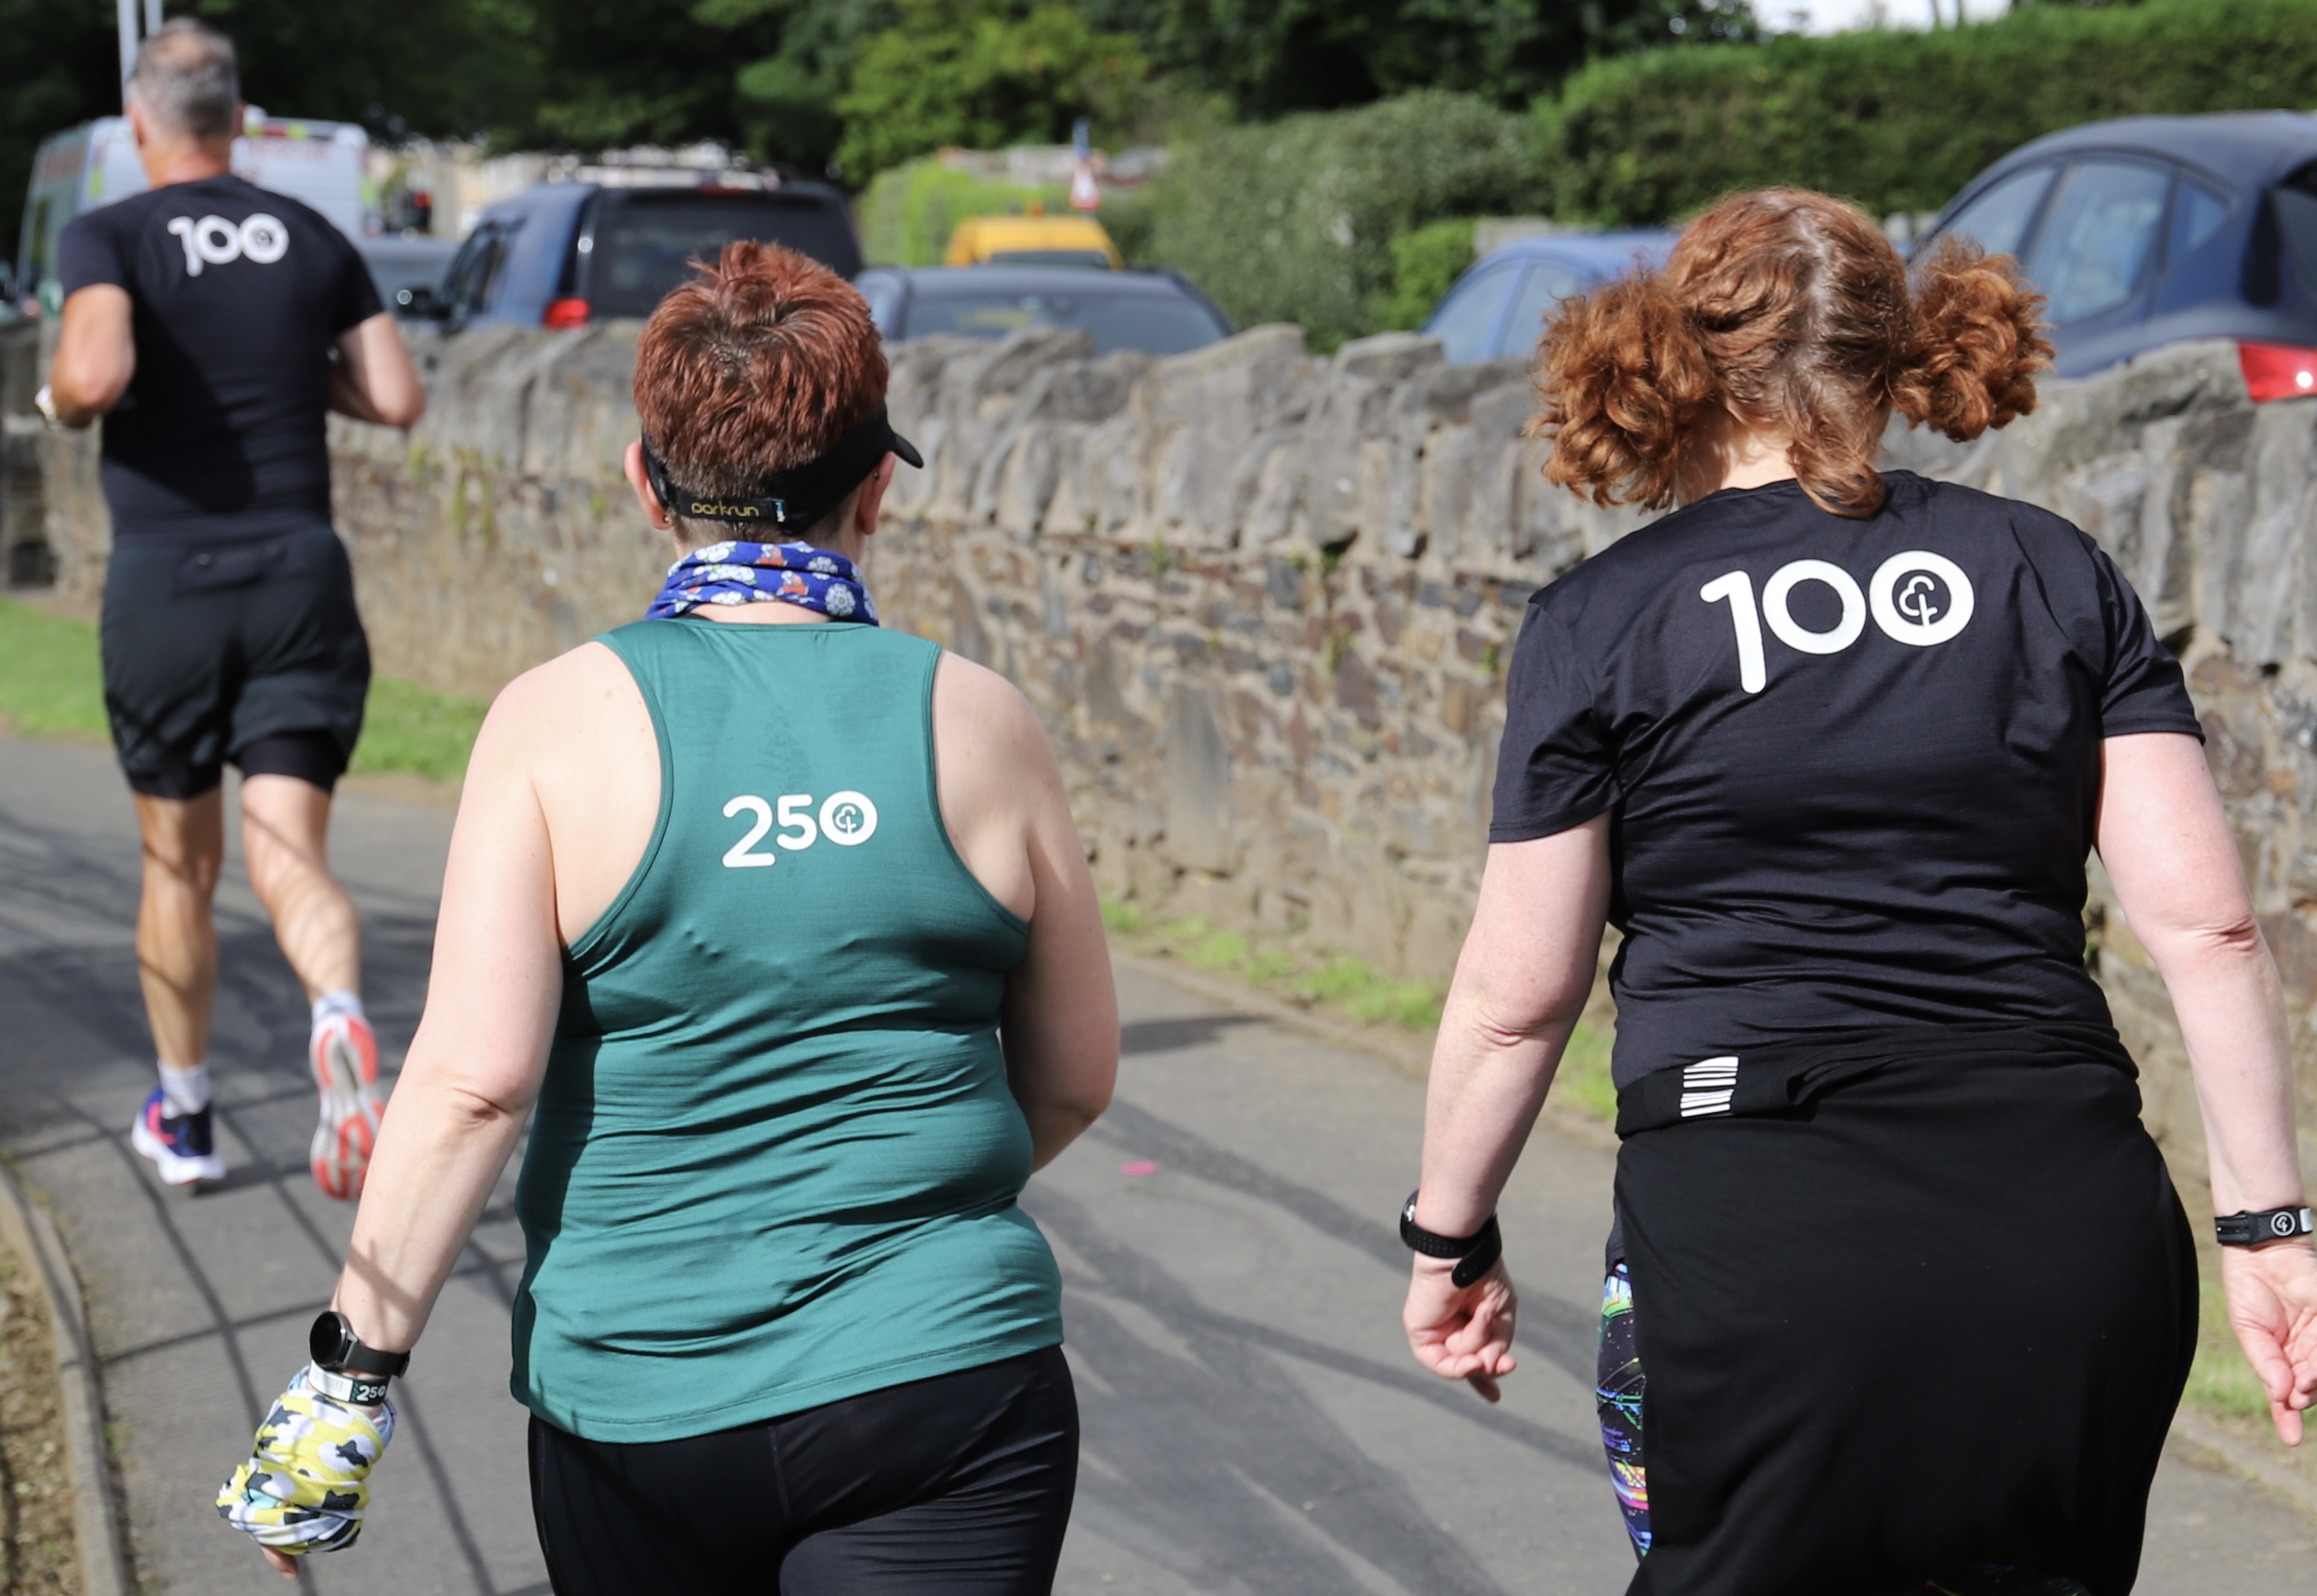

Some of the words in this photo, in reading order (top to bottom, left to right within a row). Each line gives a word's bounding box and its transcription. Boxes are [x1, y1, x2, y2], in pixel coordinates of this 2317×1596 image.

[167, 213, 289, 276] 100
[691, 500, 759, 516] parkrun
[1700, 550, 1974, 693] 100
[722, 791, 877, 867] 250
[357, 1385, 385, 1401] 250
